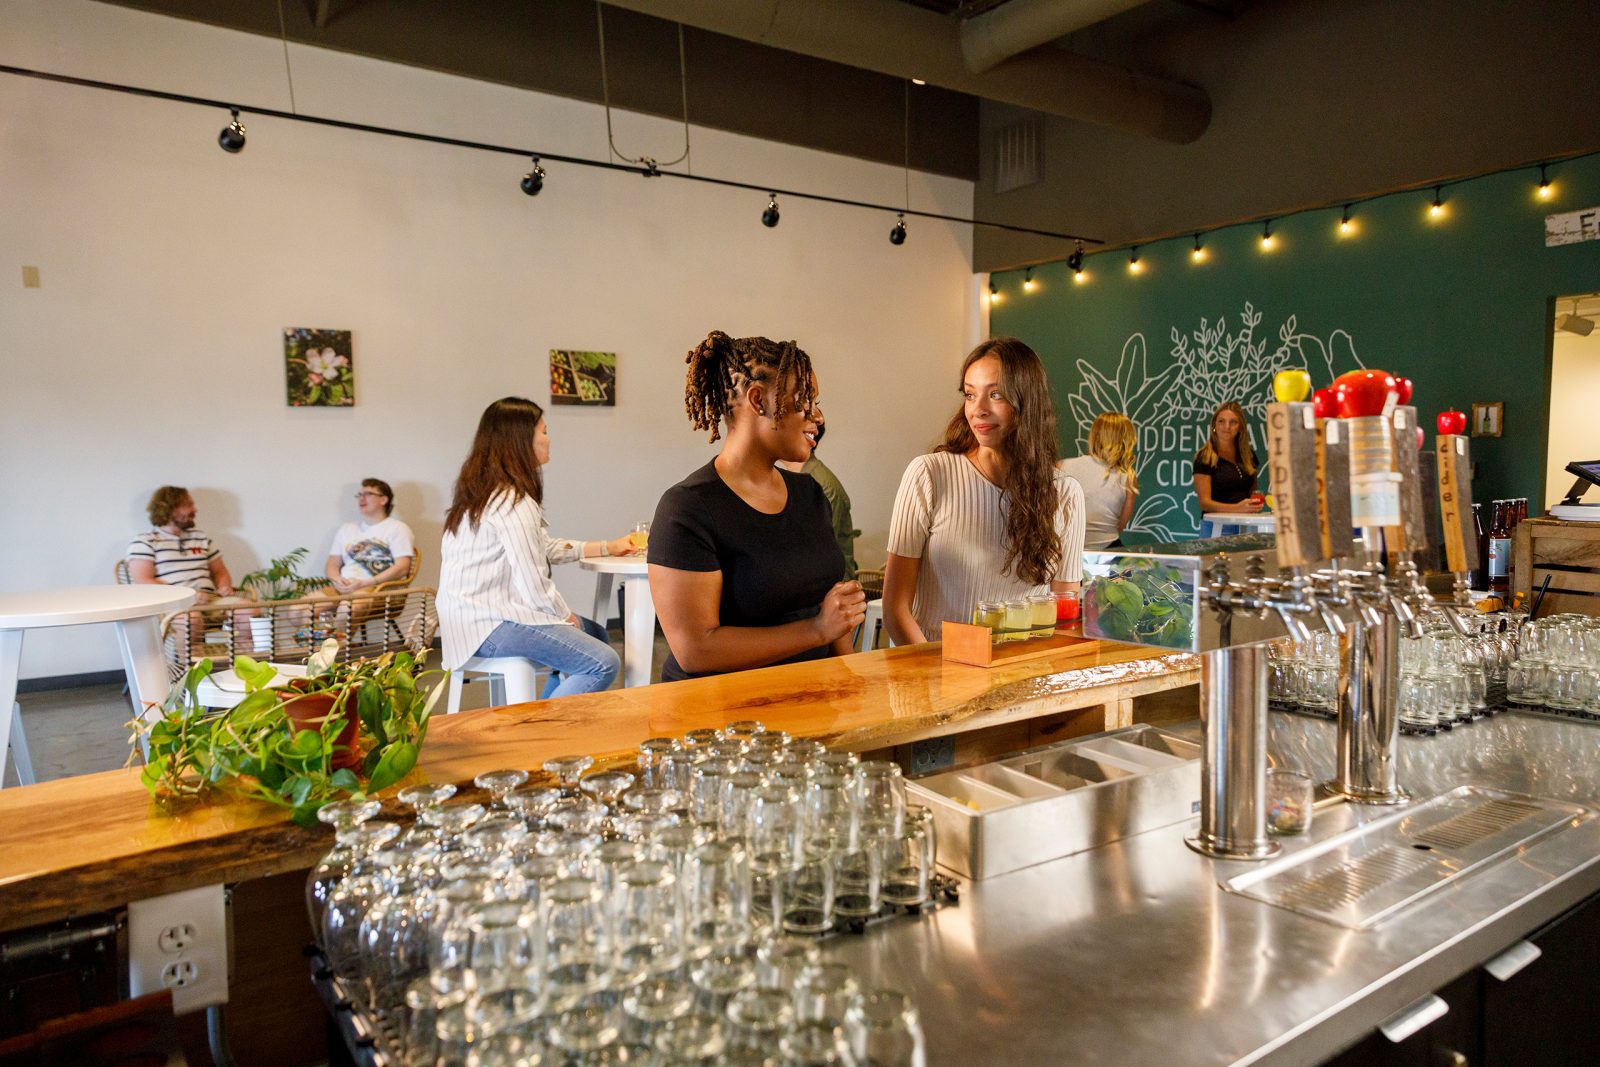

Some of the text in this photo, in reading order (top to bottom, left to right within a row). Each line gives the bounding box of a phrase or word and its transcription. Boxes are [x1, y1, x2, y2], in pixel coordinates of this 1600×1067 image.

[1136, 424, 1211, 452] IDDEN
[1156, 459, 1195, 487] CID
[1271, 411, 1293, 535] CIDER
